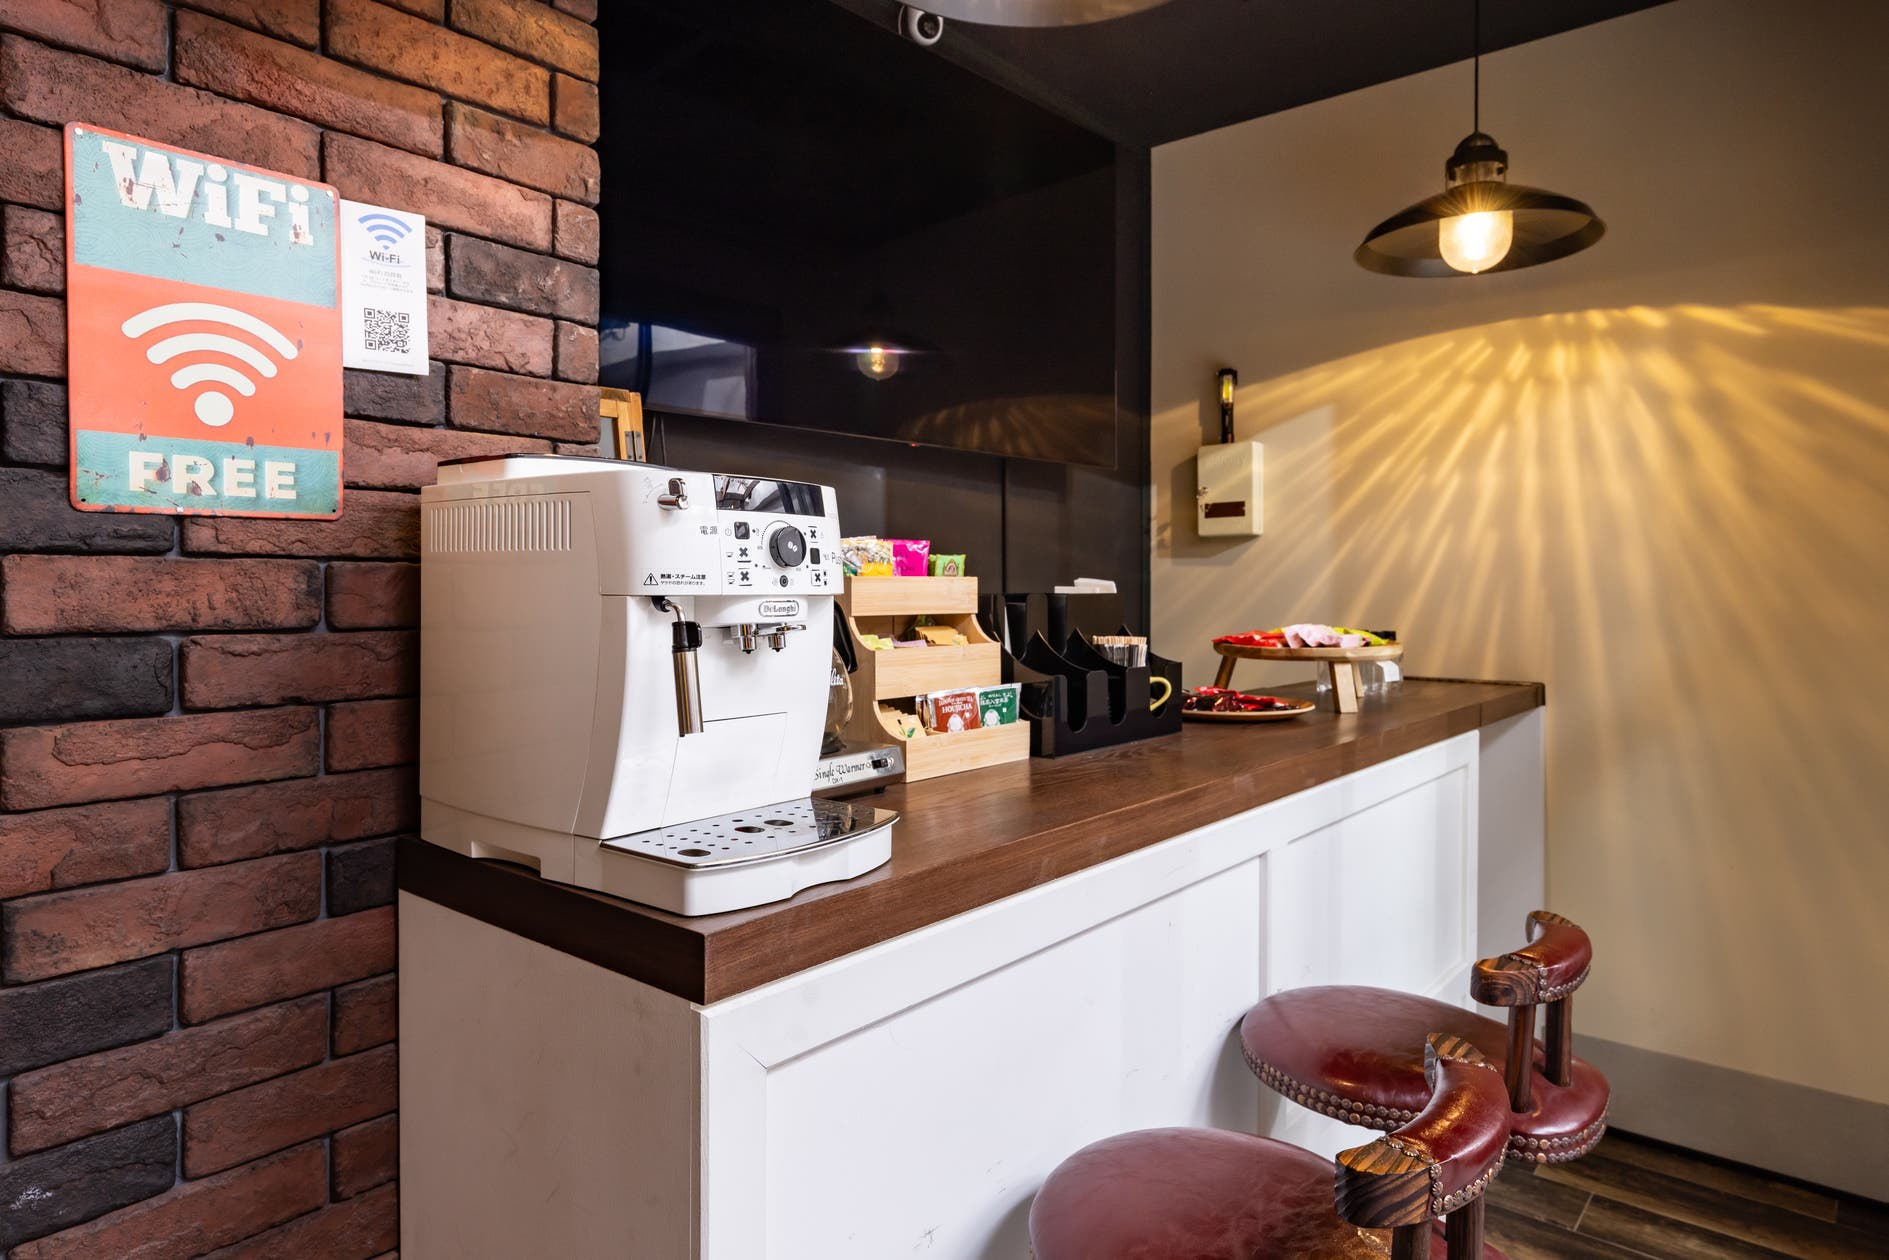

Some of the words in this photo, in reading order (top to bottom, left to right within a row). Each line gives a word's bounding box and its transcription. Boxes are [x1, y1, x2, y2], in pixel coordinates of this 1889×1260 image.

[102, 139, 314, 246] WiFi
[369, 250, 401, 265] Wi-Fi
[128, 450, 298, 500] FREE
[699, 525, 718, 535] 電源
[814, 761, 835, 784] Single
